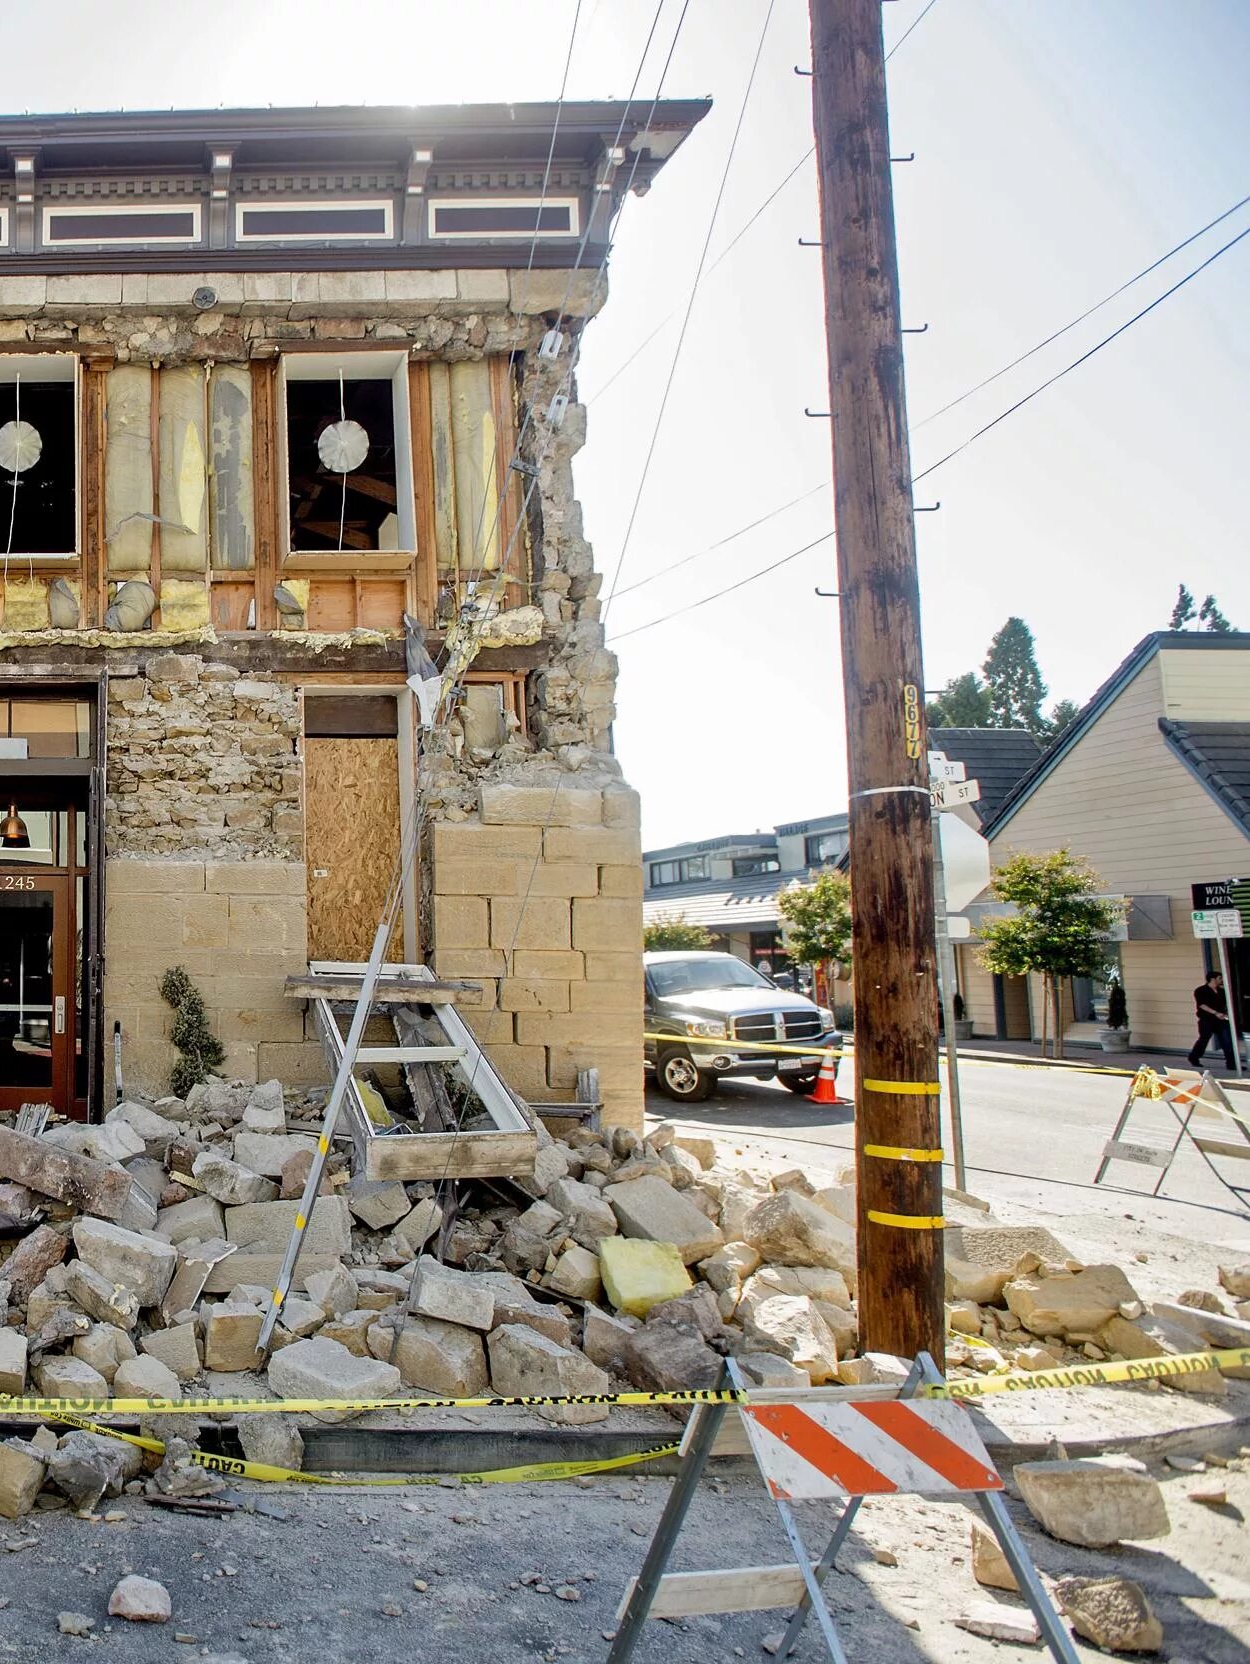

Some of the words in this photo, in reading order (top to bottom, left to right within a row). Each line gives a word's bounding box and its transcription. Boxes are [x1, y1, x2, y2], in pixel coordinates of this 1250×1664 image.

[905, 686, 919, 758] 9677
[944, 766, 955, 776] ST
[958, 788, 969, 798] ST
[1205, 886, 1232, 895] WINE
